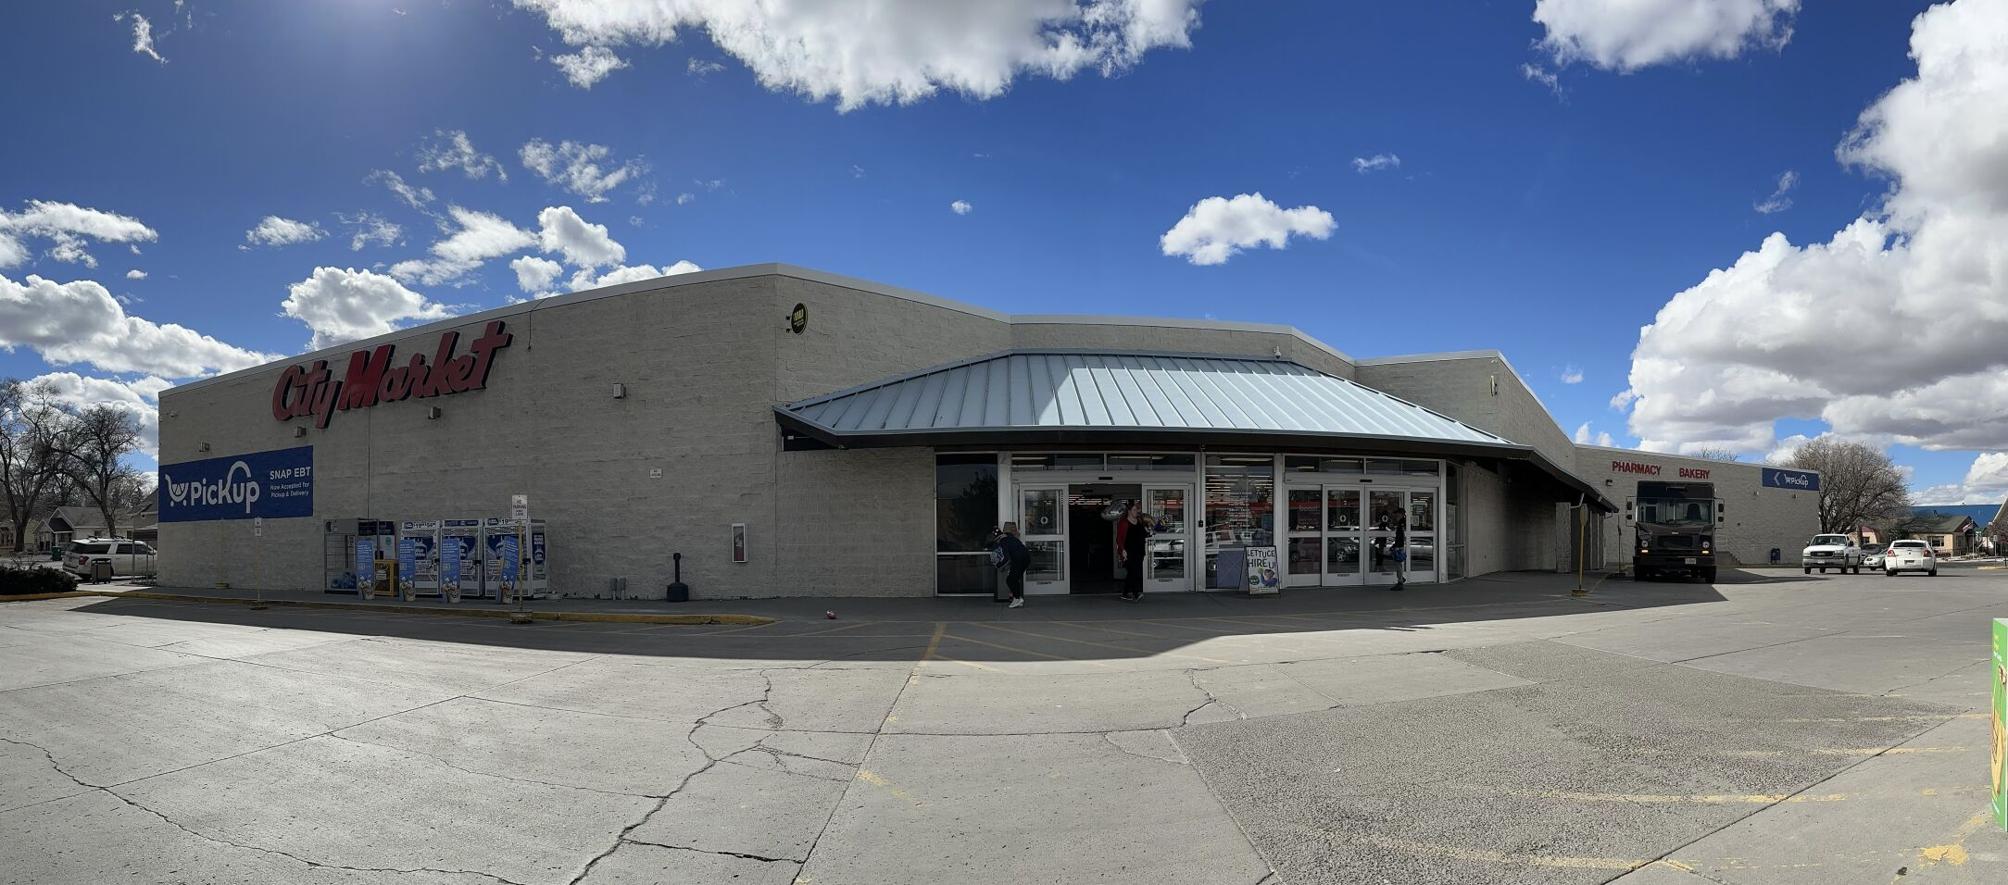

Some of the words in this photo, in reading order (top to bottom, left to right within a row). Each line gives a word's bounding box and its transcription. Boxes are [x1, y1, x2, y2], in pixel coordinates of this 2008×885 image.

[272, 360, 342, 429] City
[337, 320, 514, 410] Market
[270, 469, 292, 480] SNAP
[294, 466, 311, 477] EBT
[1612, 461, 1662, 475] PHARMACY
[1679, 467, 1710, 479] BAKERY
[1248, 549, 1276, 558] LETTUCE
[1248, 558, 1268, 568] HIRE
